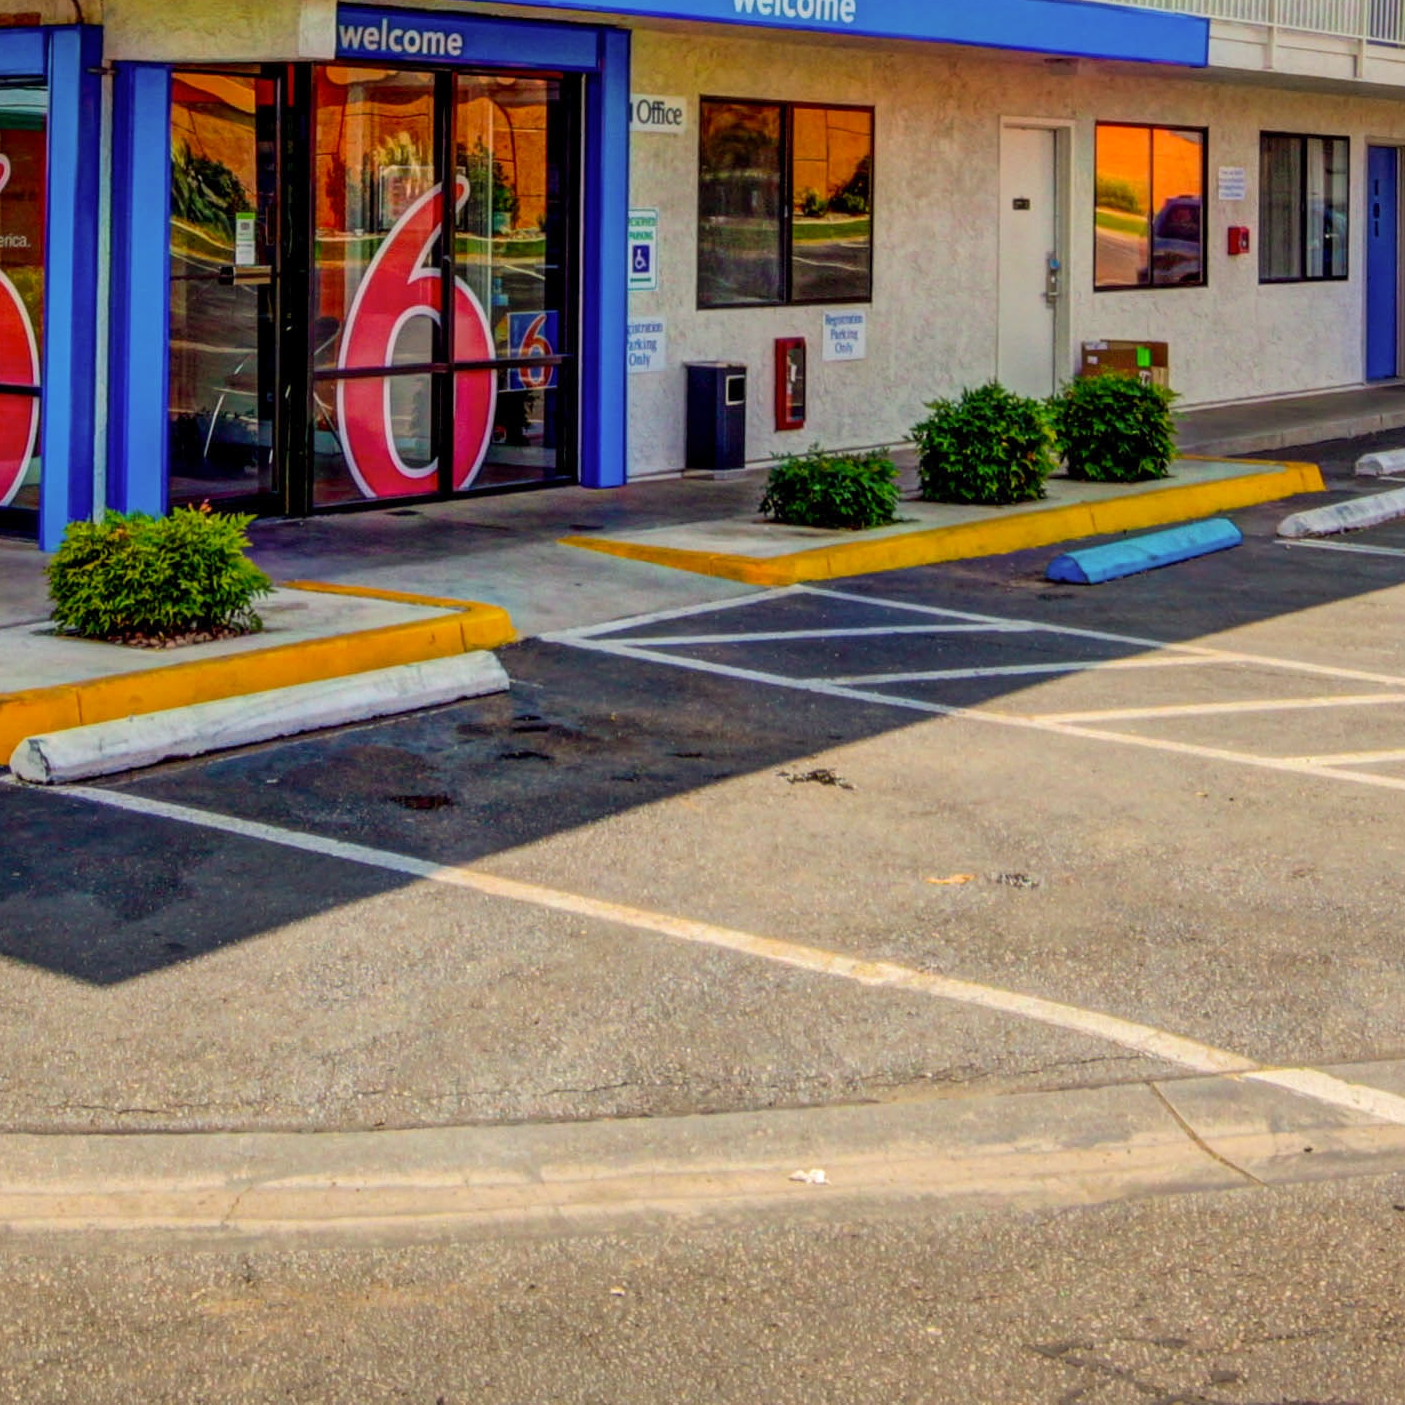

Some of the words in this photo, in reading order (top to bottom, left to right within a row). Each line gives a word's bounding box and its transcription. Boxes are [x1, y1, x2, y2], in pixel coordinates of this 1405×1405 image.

[338, 17, 463, 56] welcome
[636, 99, 683, 125] Office
[336, 175, 496, 498] 6
[628, 339, 658, 353] arking
[835, 342, 853, 355] Only
[519, 314, 553, 389] 6
[629, 353, 651, 370] Only
